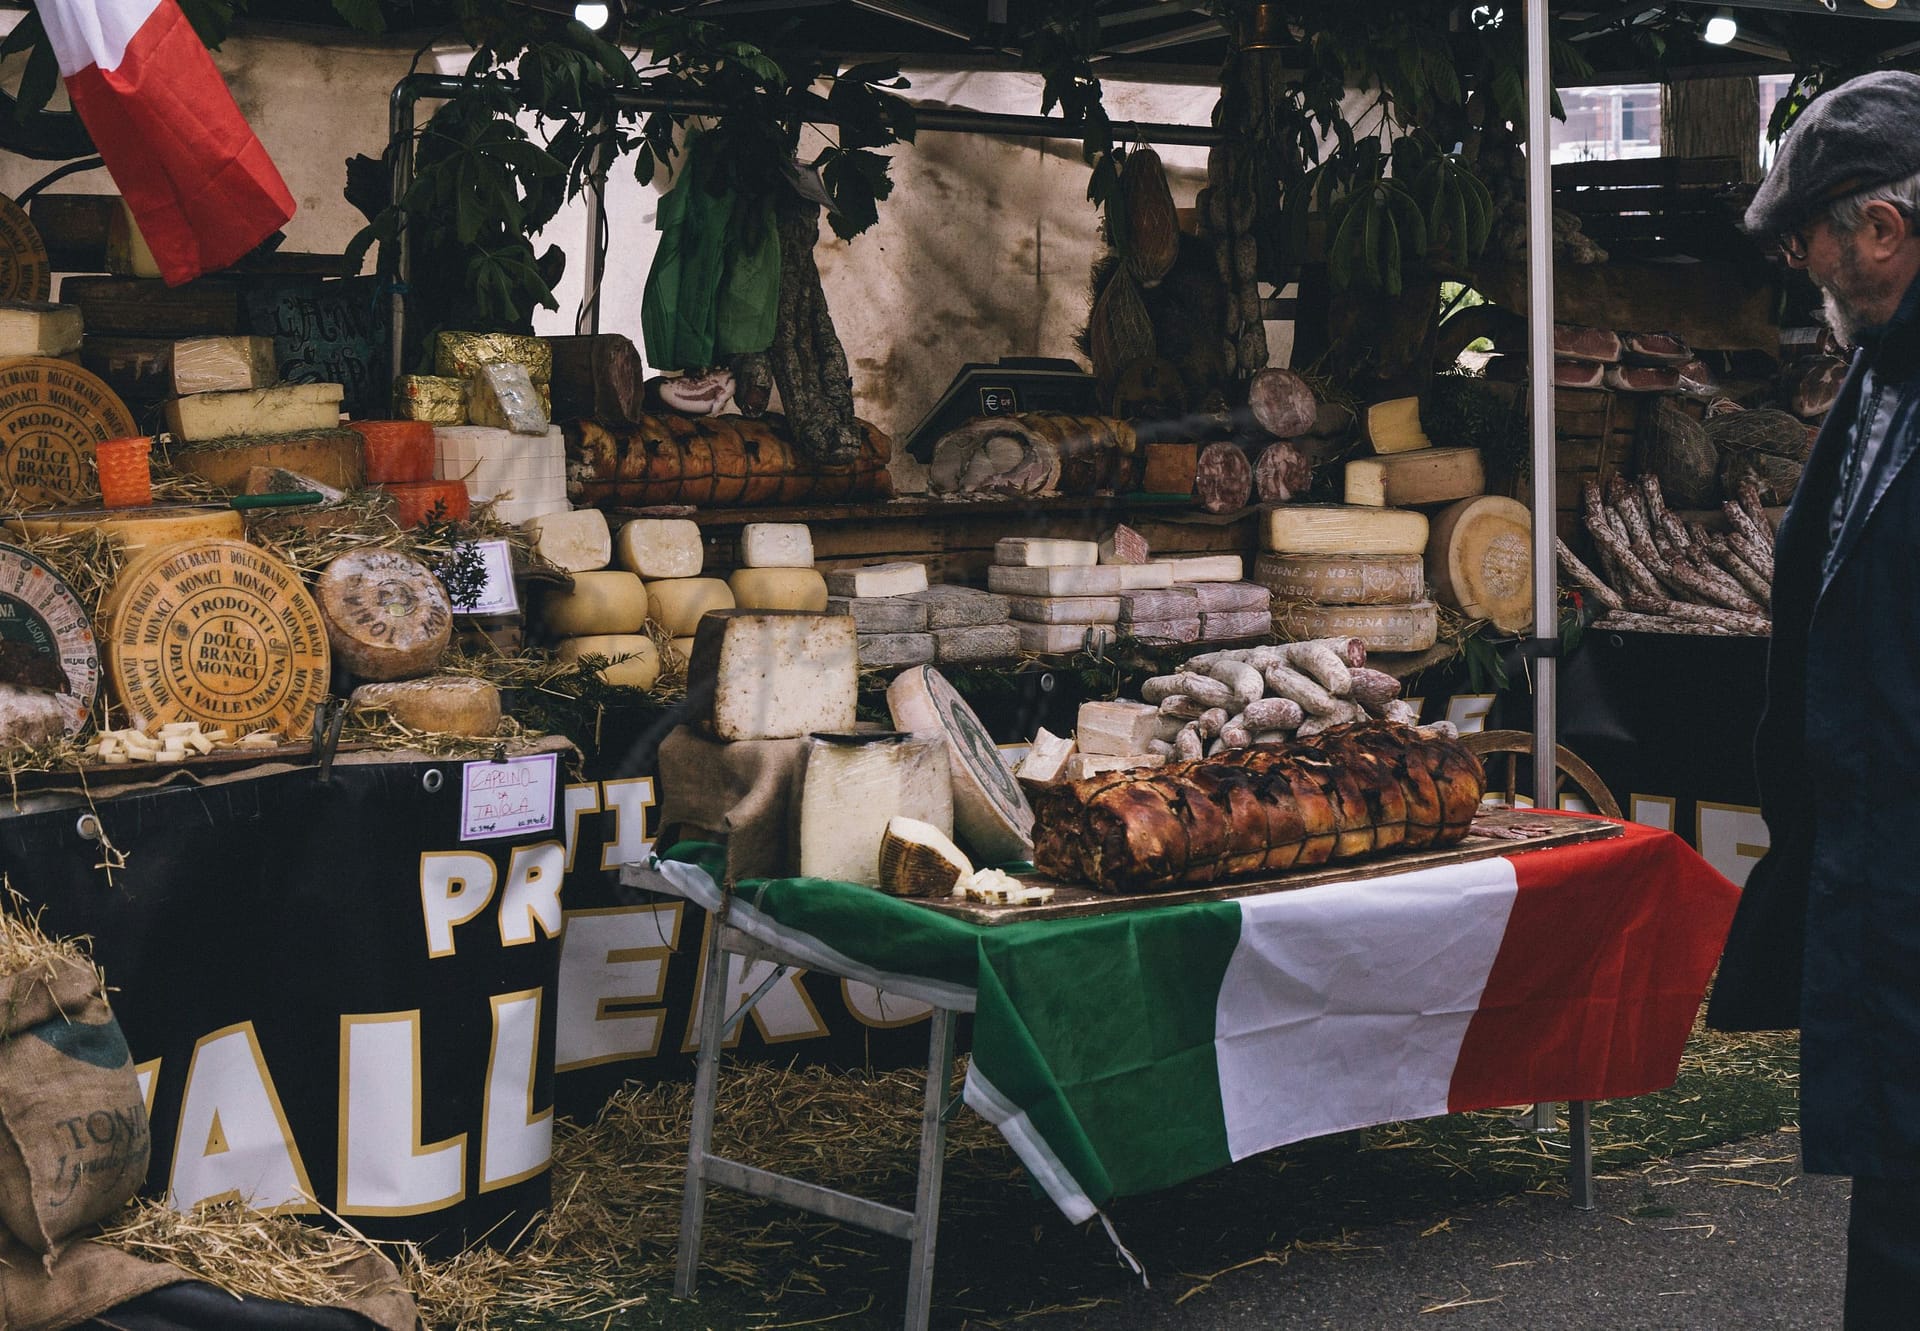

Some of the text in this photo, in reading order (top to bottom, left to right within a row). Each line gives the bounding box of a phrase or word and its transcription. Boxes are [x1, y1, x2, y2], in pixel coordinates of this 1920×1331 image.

[8, 413, 88, 447] PRODOTTI
[38, 436, 52, 448] IL
[17, 460, 70, 478] BRANZI
[20, 447, 69, 464] DOLCE
[14, 473, 71, 490] MONACI
[160, 549, 222, 581] DOLCE BRANZI
[230, 550, 289, 590] DOLCE BRANZI
[176, 569, 222, 597] MONACI
[232, 570, 278, 602] MONACI
[123, 581, 160, 645] DOLCE BRANZI
[143, 598, 173, 644] MONACI
[190, 596, 275, 633] PRODOTTI
[223, 621, 238, 634] IL
[291, 593, 323, 657] DOLCE BRANZI
[203, 632, 256, 650] DOLCE
[279, 606, 307, 654] MONACI
[196, 661, 259, 681] MONACI
[200, 647, 258, 665] BRANZI
[123, 658, 158, 721] DOLCE BRANZI
[143, 659, 170, 707] MONACI
[170, 644, 286, 714] DELLA VALLE IMAGNA
[282, 667, 307, 713] MONACI
[471, 768, 531, 790] CAPRINO
[134, 986, 554, 1217] ALL
